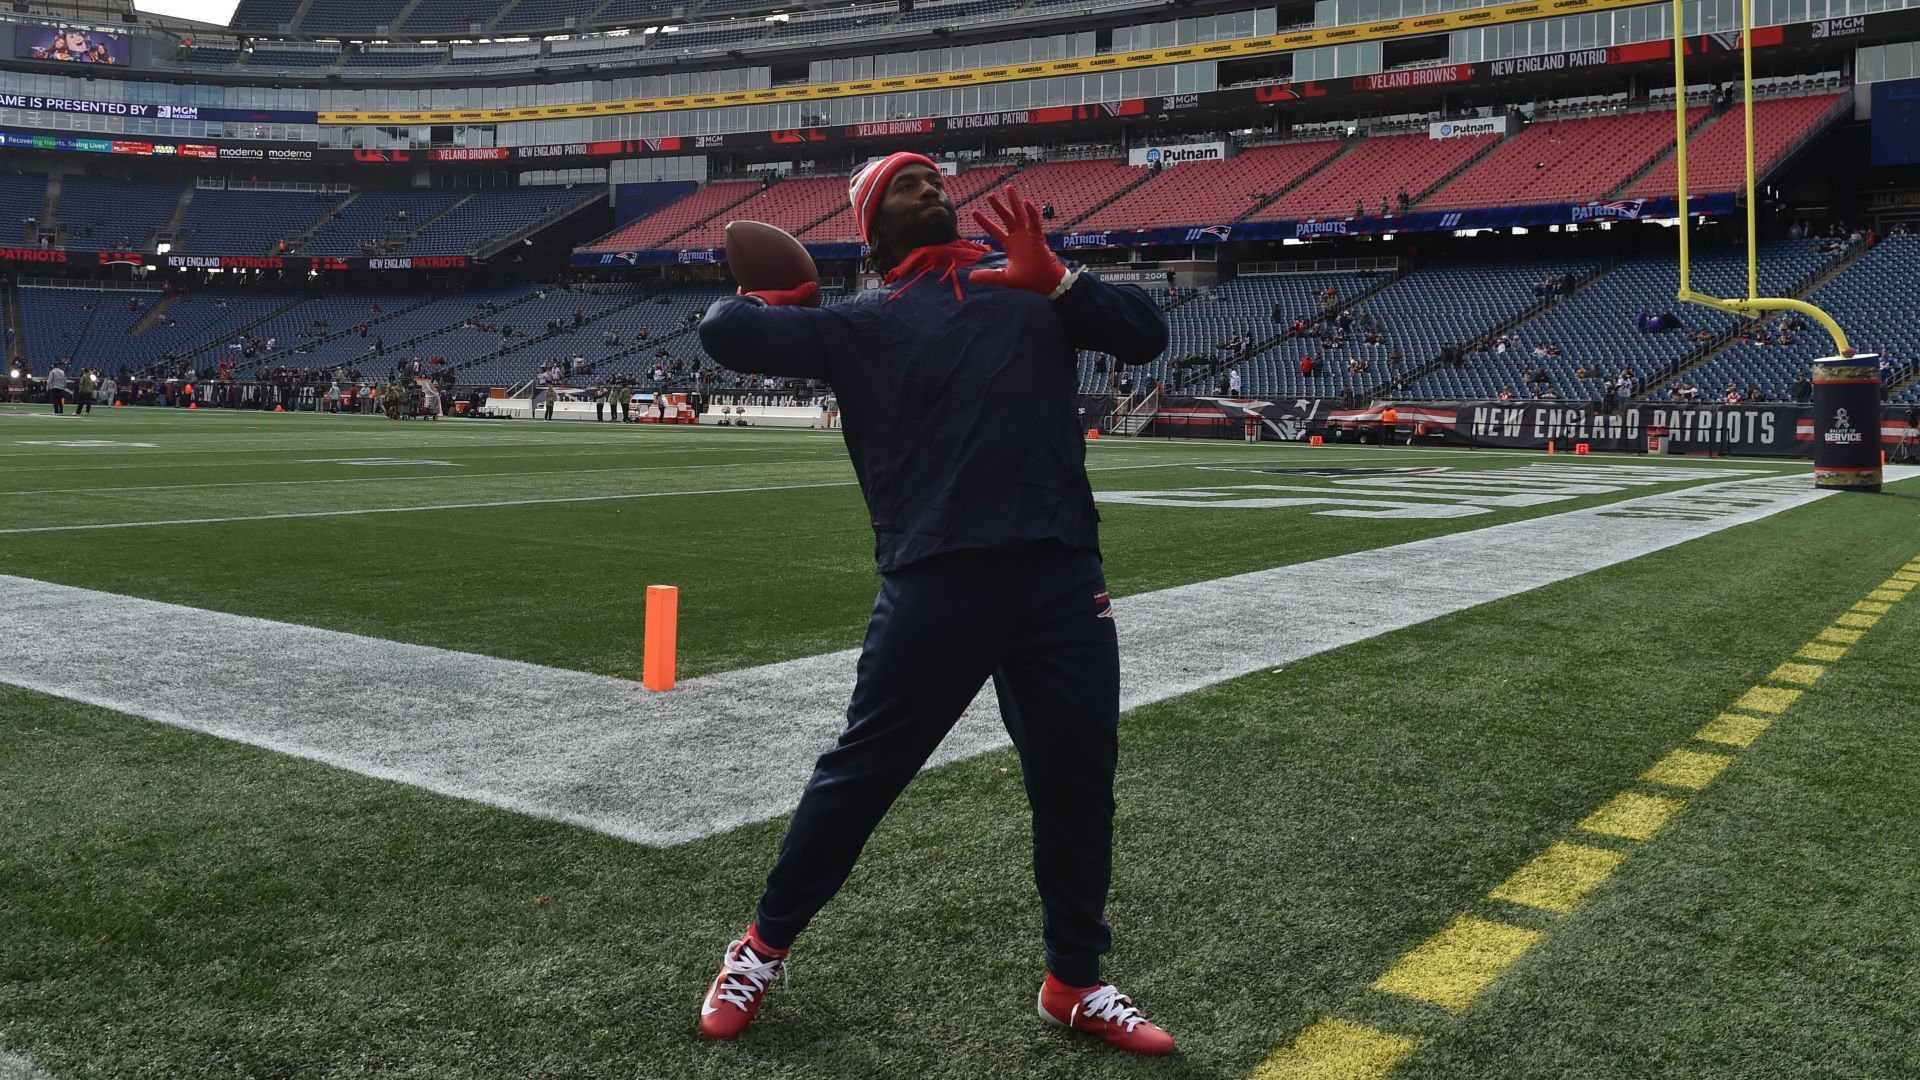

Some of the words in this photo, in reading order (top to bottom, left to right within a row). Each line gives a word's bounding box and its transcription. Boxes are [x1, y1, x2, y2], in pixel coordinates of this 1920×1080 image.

[1831, 16, 1864, 29] MGM
[1831, 27, 1864, 36] RESORTS
[1491, 59, 1514, 76] NEW
[1516, 55, 1564, 74] ENGLAND
[1413, 66, 1457, 84] BROWNS
[1176, 95, 1198, 103] MGM
[30, 97, 42, 108] IS
[46, 98, 126, 114] PRESENTED
[130, 104, 148, 116] BY
[890, 121, 922, 134] BROWNS
[947, 117, 965, 129] NEW
[966, 114, 999, 128] ENGLAND
[1453, 122, 1494, 134] Putnam
[8, 136, 43, 146] Recovering
[220, 148, 264, 156] moderna
[268, 149, 312, 158] moderna
[468, 148, 499, 160] BROWNS
[518, 147, 534, 158] NEW
[534, 145, 562, 156] ENGLAND
[1164, 148, 1218, 161] Putnam
[1572, 203, 1628, 222] PATRIOT
[1296, 222, 1346, 236] PATRIOTS
[1064, 234, 1106, 248] PATRIOTS
[0, 249, 66, 262] PATRIOTS
[168, 256, 186, 266] NEW
[186, 257, 220, 267] ENGLAND
[221, 256, 284, 268] PATRIOTS
[678, 252, 714, 262] PATRIOTS
[370, 259, 384, 269] NEW
[384, 258, 412, 268] ENGLAND
[412, 257, 465, 268] PATRIOTS
[1100, 274, 1140, 282] CHAMPIONS
[1472, 407, 1525, 438] NEW
[1534, 408, 1640, 440] ENGLAND
[1653, 409, 1775, 445] PATRIOTS
[1824, 434, 1862, 442] SERVICE
